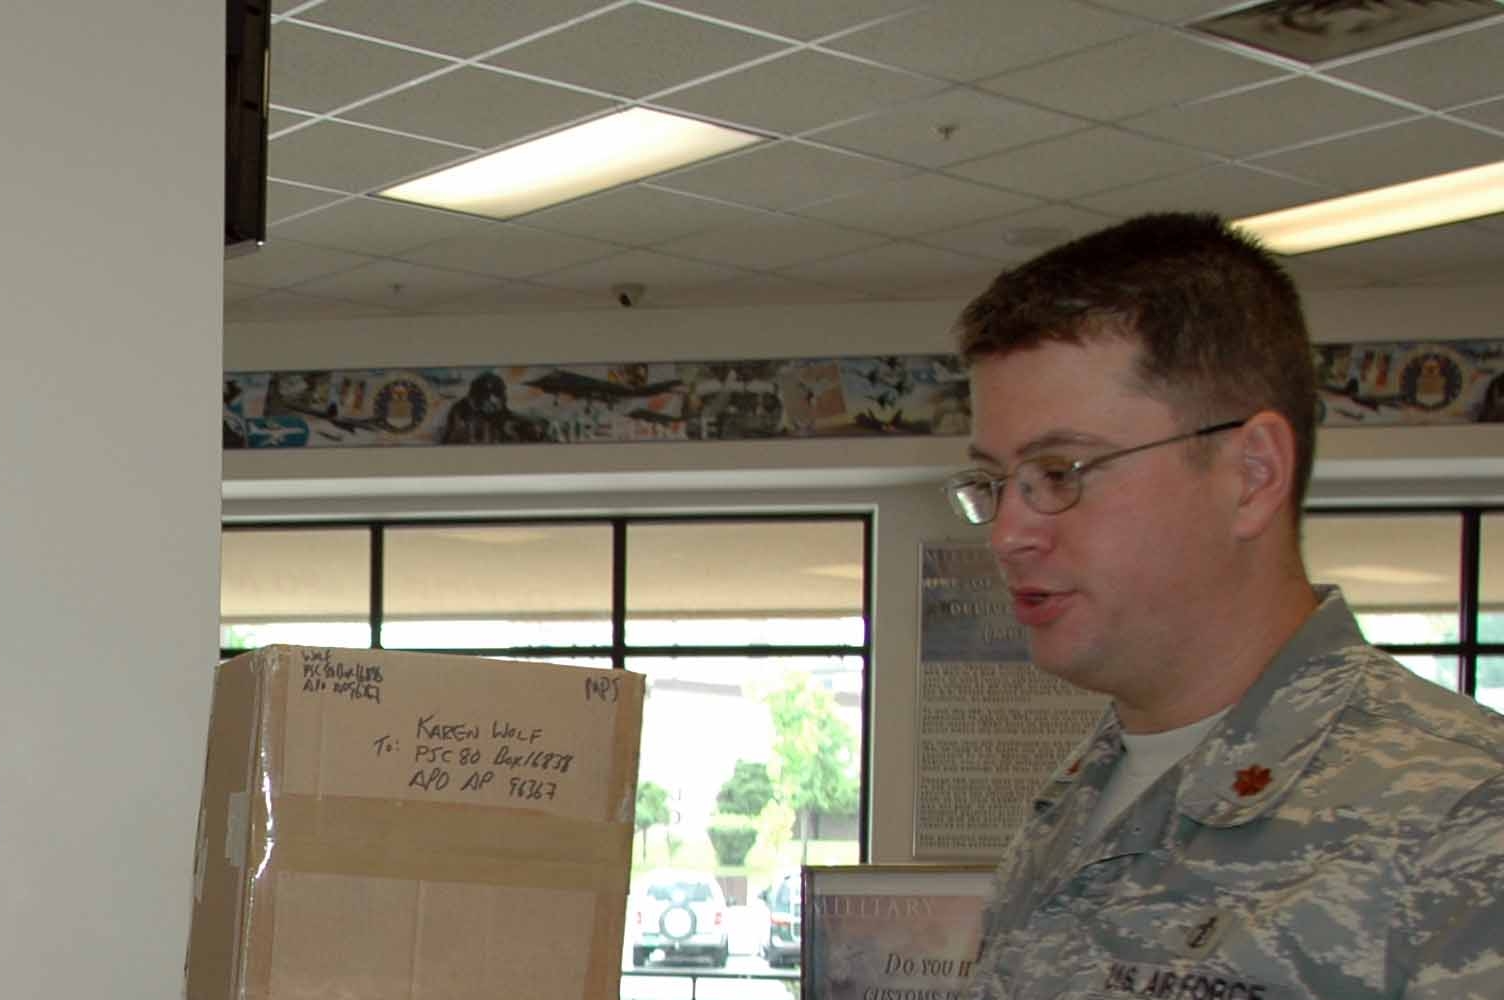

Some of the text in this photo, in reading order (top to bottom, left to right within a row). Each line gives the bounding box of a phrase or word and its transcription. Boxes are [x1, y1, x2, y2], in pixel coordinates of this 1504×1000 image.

[459, 747, 481, 766] 80
[408, 767, 450, 791] APO
[460, 771, 495, 792] AP
[811, 898, 932, 920] MILITARY
[1144, 968, 1177, 999] AIR
